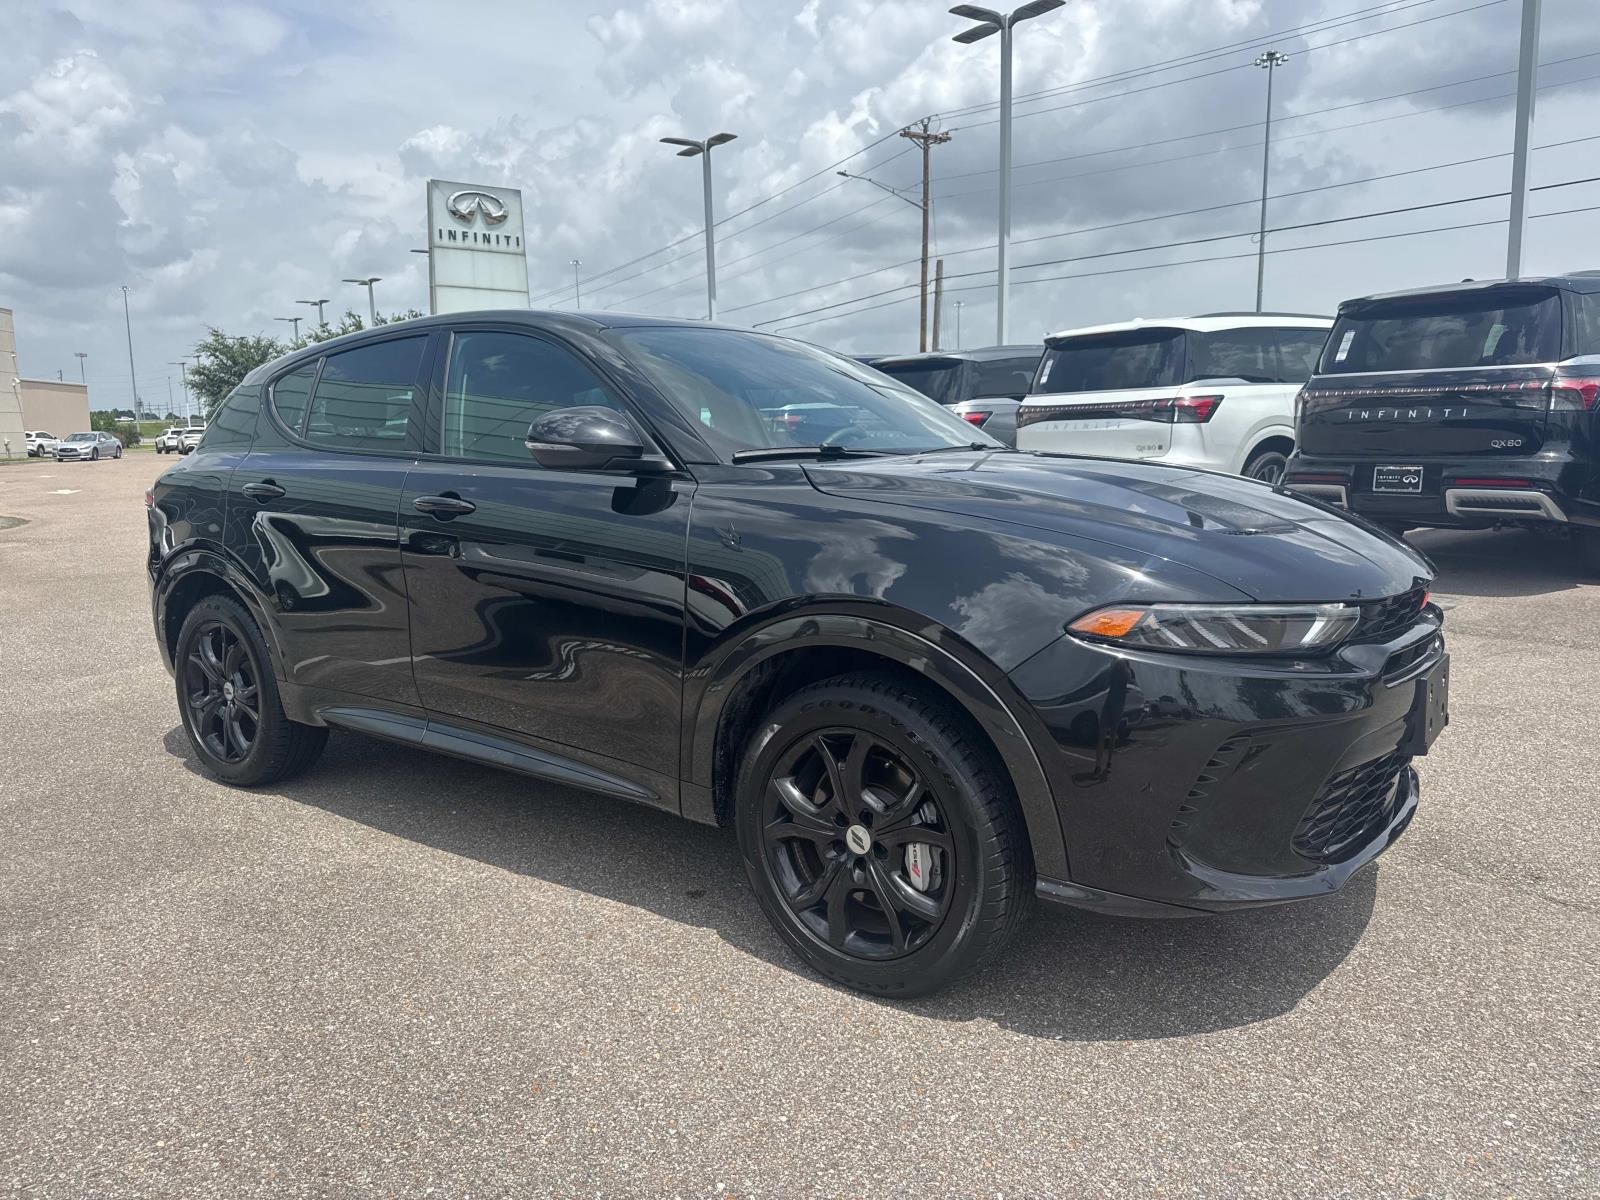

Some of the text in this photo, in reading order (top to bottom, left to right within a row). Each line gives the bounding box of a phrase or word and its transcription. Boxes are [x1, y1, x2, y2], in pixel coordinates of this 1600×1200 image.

[438, 228, 520, 247] INFINITI
[1349, 408, 1467, 419] INFINITI
[1045, 421, 1121, 430] INFINITI
[1491, 439, 1522, 448] QX80
